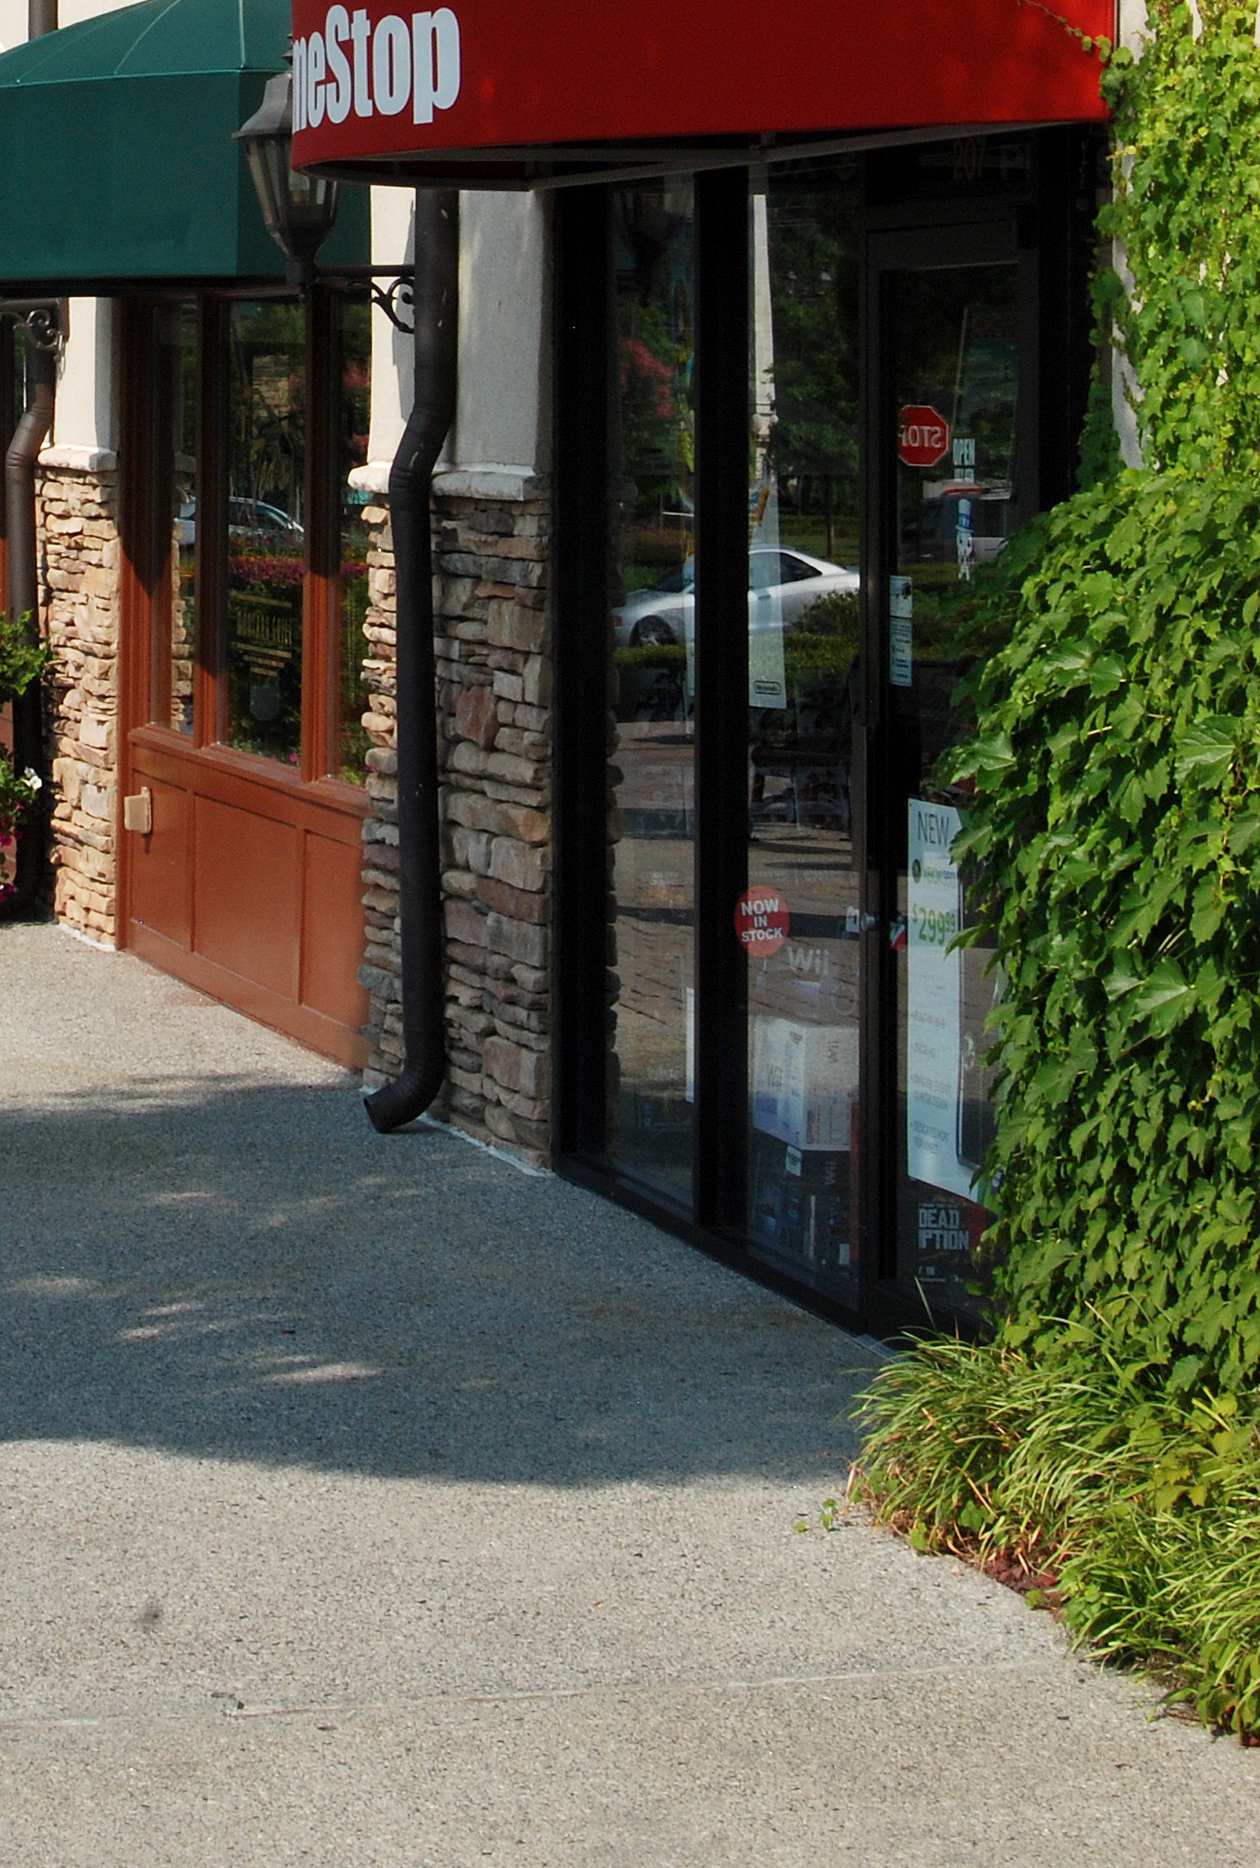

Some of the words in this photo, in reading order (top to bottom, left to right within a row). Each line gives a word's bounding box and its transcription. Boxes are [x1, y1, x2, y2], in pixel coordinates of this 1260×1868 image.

[917, 810, 950, 847] NEW
[741, 898, 779, 916] NOW
[753, 914, 768, 928] IN
[741, 927, 783, 943] STOCK
[786, 945, 830, 976] Wii
[918, 1207, 961, 1229] DEAD
